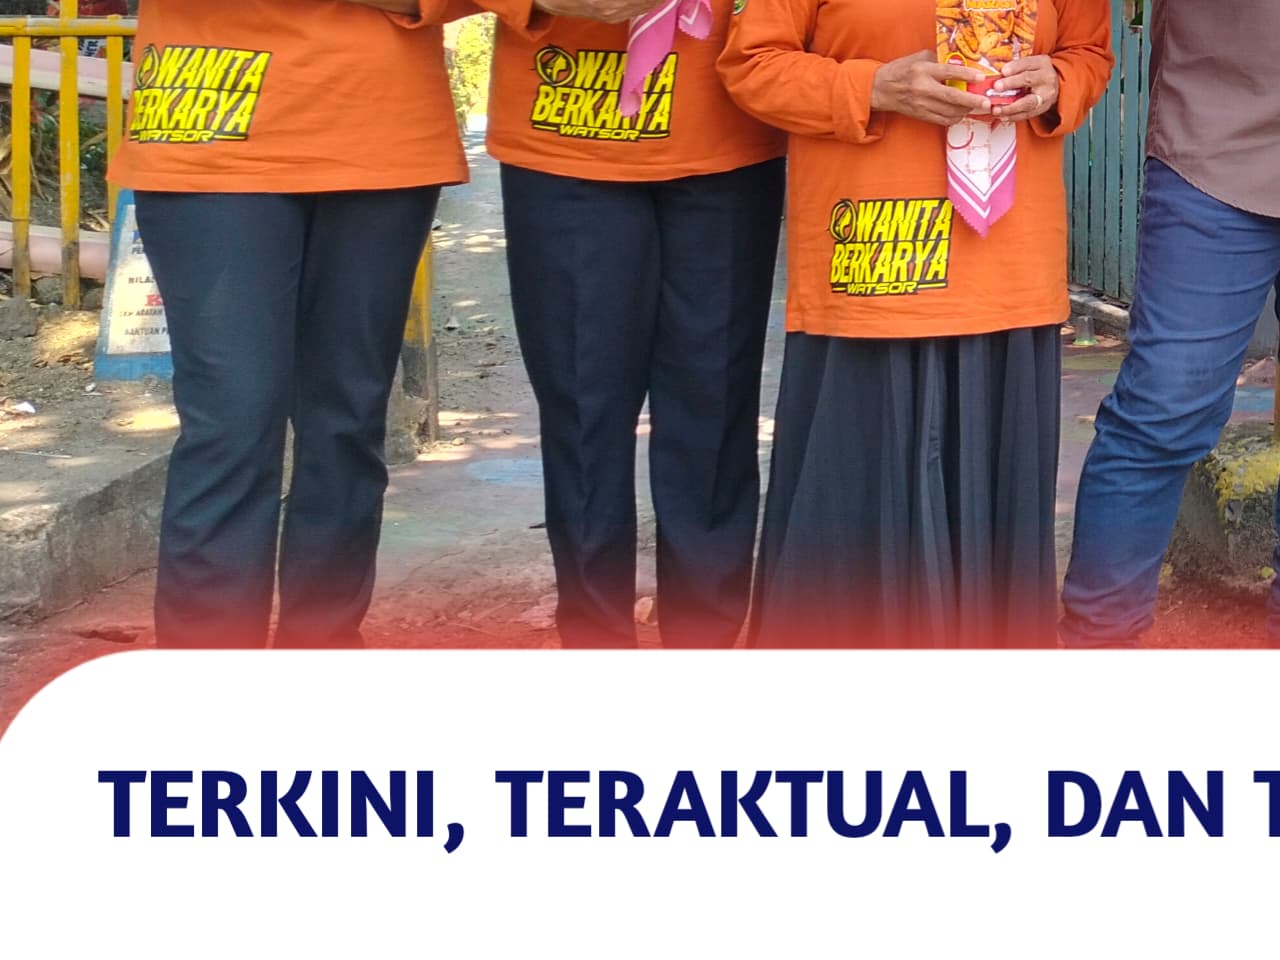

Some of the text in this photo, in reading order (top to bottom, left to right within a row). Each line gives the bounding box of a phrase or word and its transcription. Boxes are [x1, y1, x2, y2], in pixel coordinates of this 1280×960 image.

[154, 46, 272, 92] WANITA
[574, 51, 678, 93] WAA
[559, 124, 641, 141] WATSOR
[856, 199, 954, 242] WANITA
[830, 240, 949, 284] BERKARYA
[846, 281, 918, 295] WATSOR
